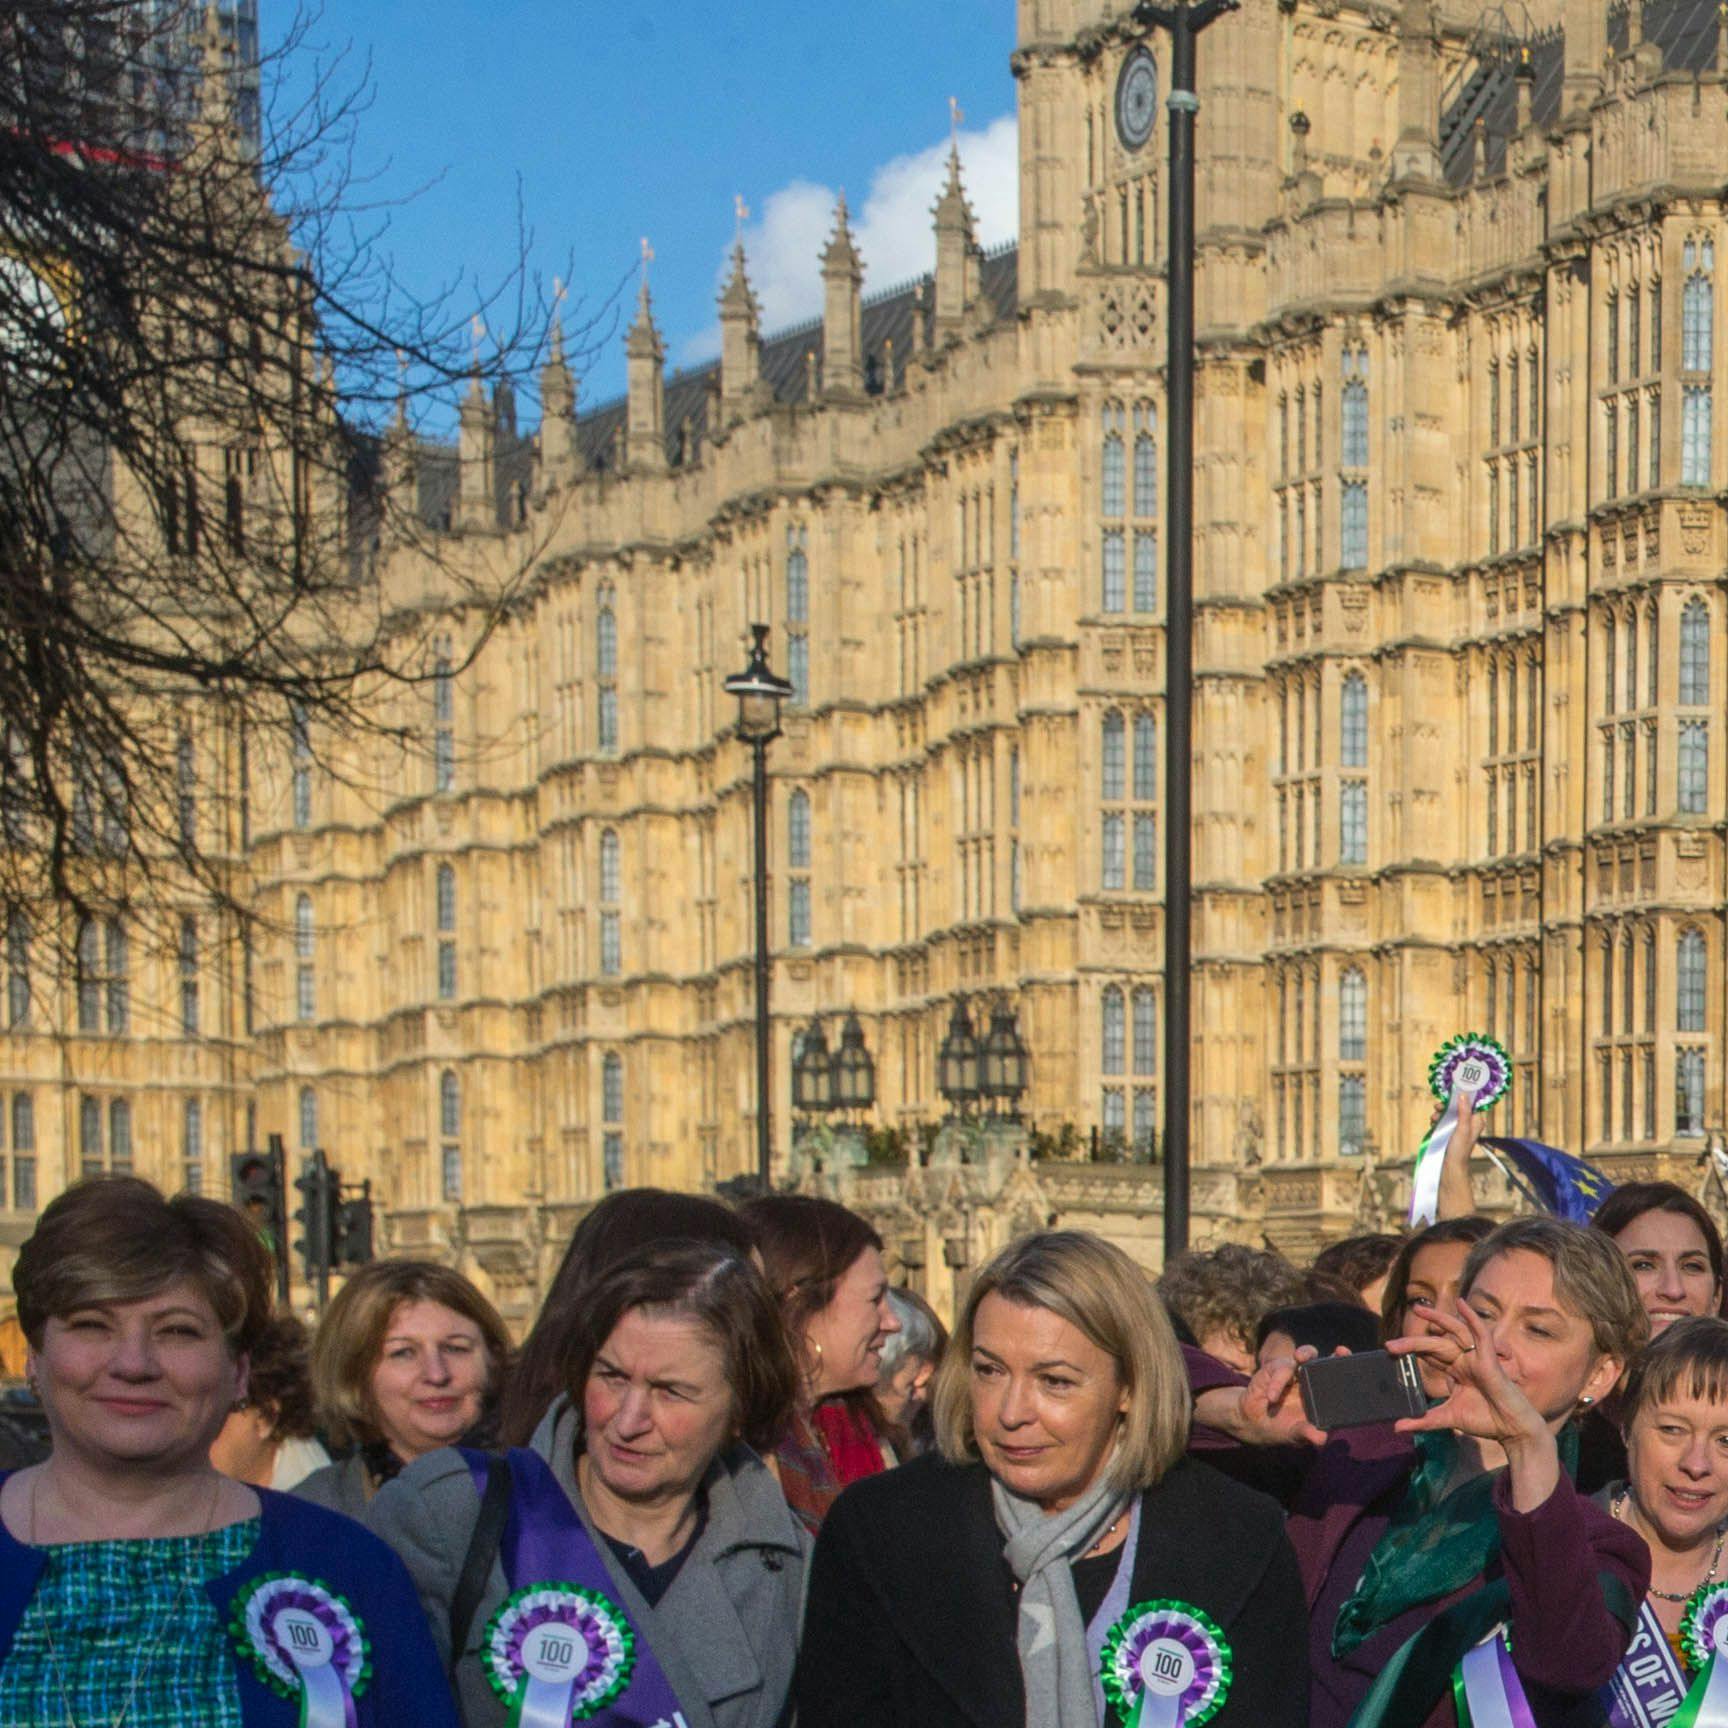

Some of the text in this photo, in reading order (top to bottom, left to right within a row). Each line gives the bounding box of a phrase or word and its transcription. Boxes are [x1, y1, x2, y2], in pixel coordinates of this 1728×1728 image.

[1462, 1065, 1480, 1082] 100
[288, 1624, 319, 1647] 100
[540, 1639, 573, 1664] 100
[1154, 1653, 1182, 1679] 100
[1629, 1652, 1670, 1690] OF
